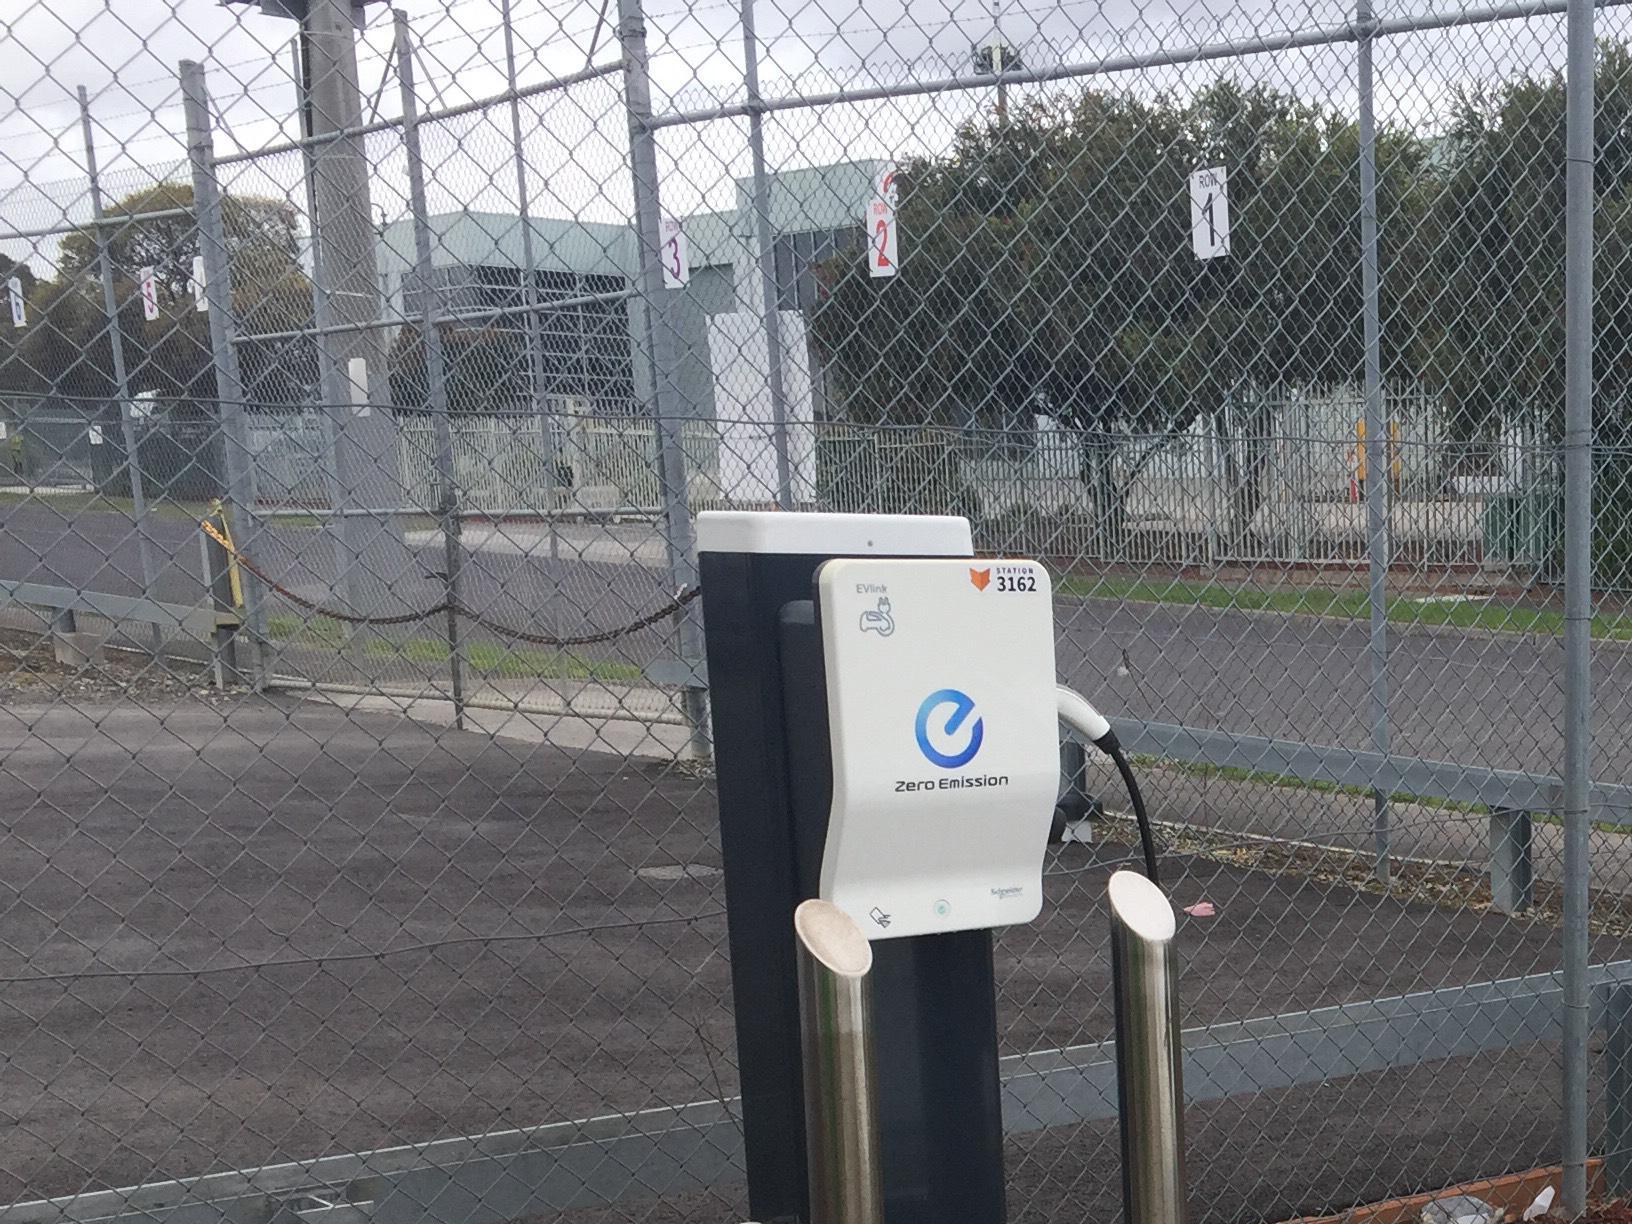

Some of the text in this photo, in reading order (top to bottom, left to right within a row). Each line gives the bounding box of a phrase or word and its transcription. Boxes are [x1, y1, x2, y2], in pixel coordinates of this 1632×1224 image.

[1199, 172, 1218, 189] ROW
[1202, 192, 1215, 247] 1
[876, 219, 890, 267] 2
[668, 236, 681, 279] 3
[996, 567, 1034, 575] STATION
[997, 576, 1037, 592] 3162
[894, 774, 1009, 792] Zero Emission
